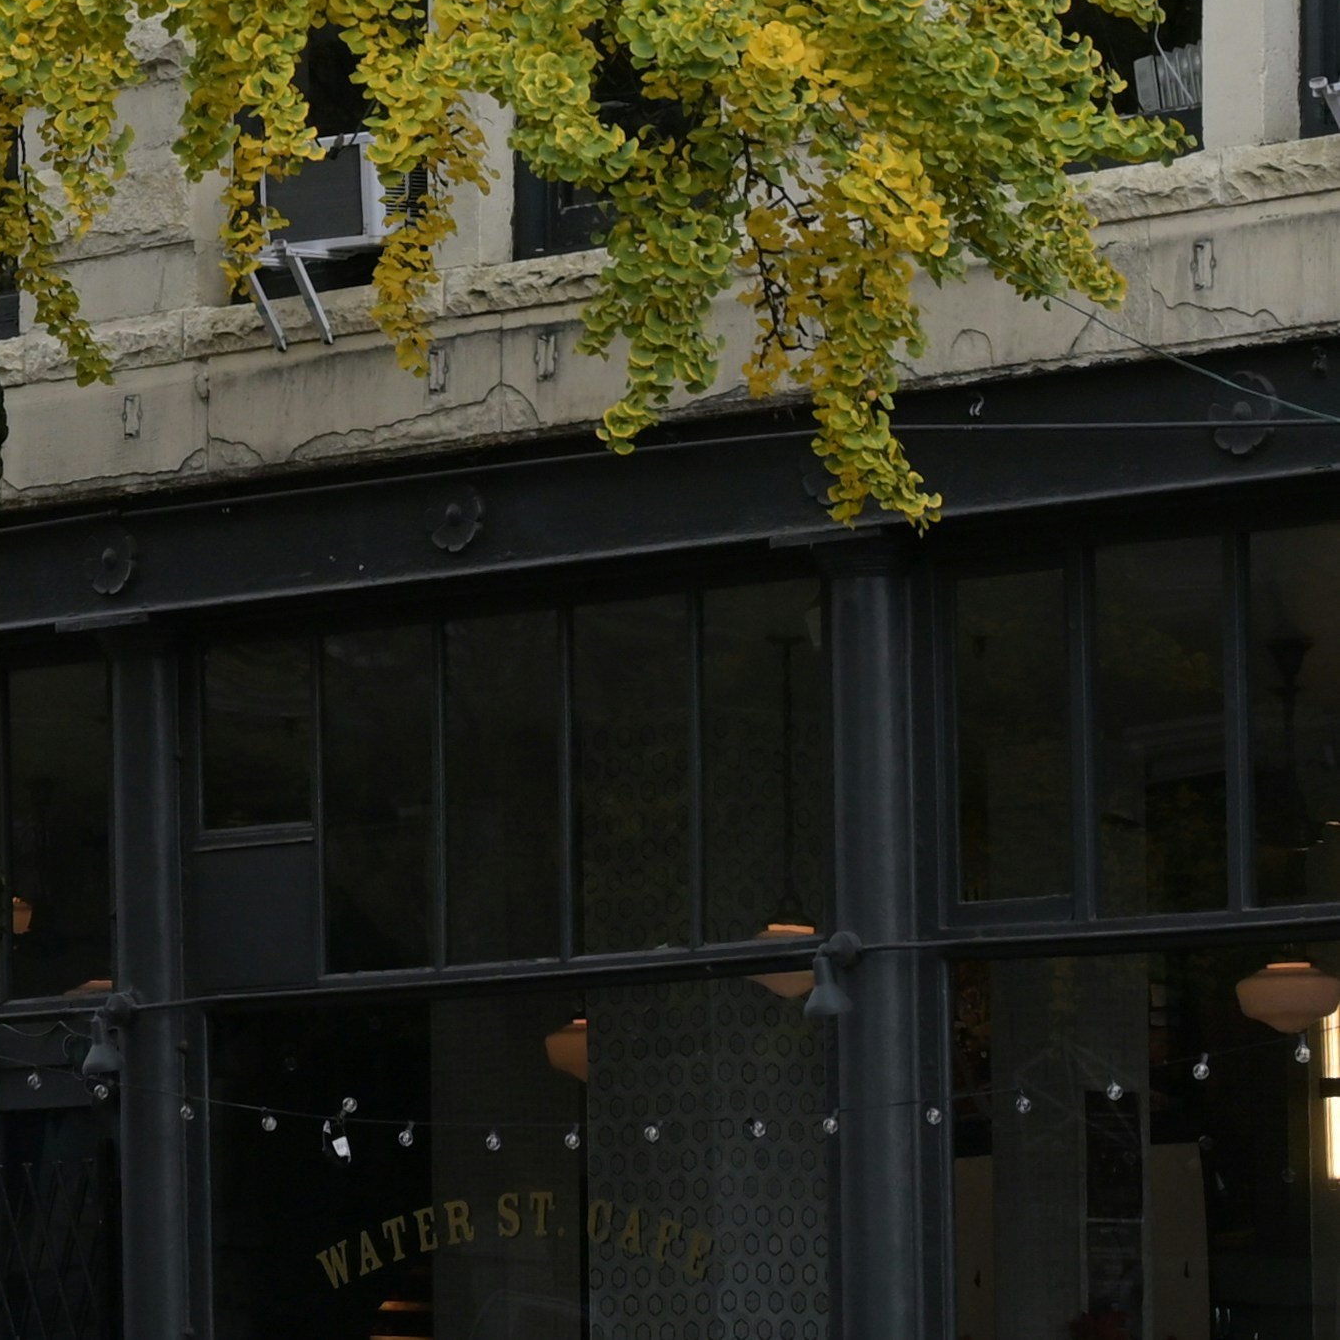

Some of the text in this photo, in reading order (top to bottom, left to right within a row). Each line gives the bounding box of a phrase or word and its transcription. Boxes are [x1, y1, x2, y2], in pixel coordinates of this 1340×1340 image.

[314, 1191, 714, 1290] WATER ST. CAFE
